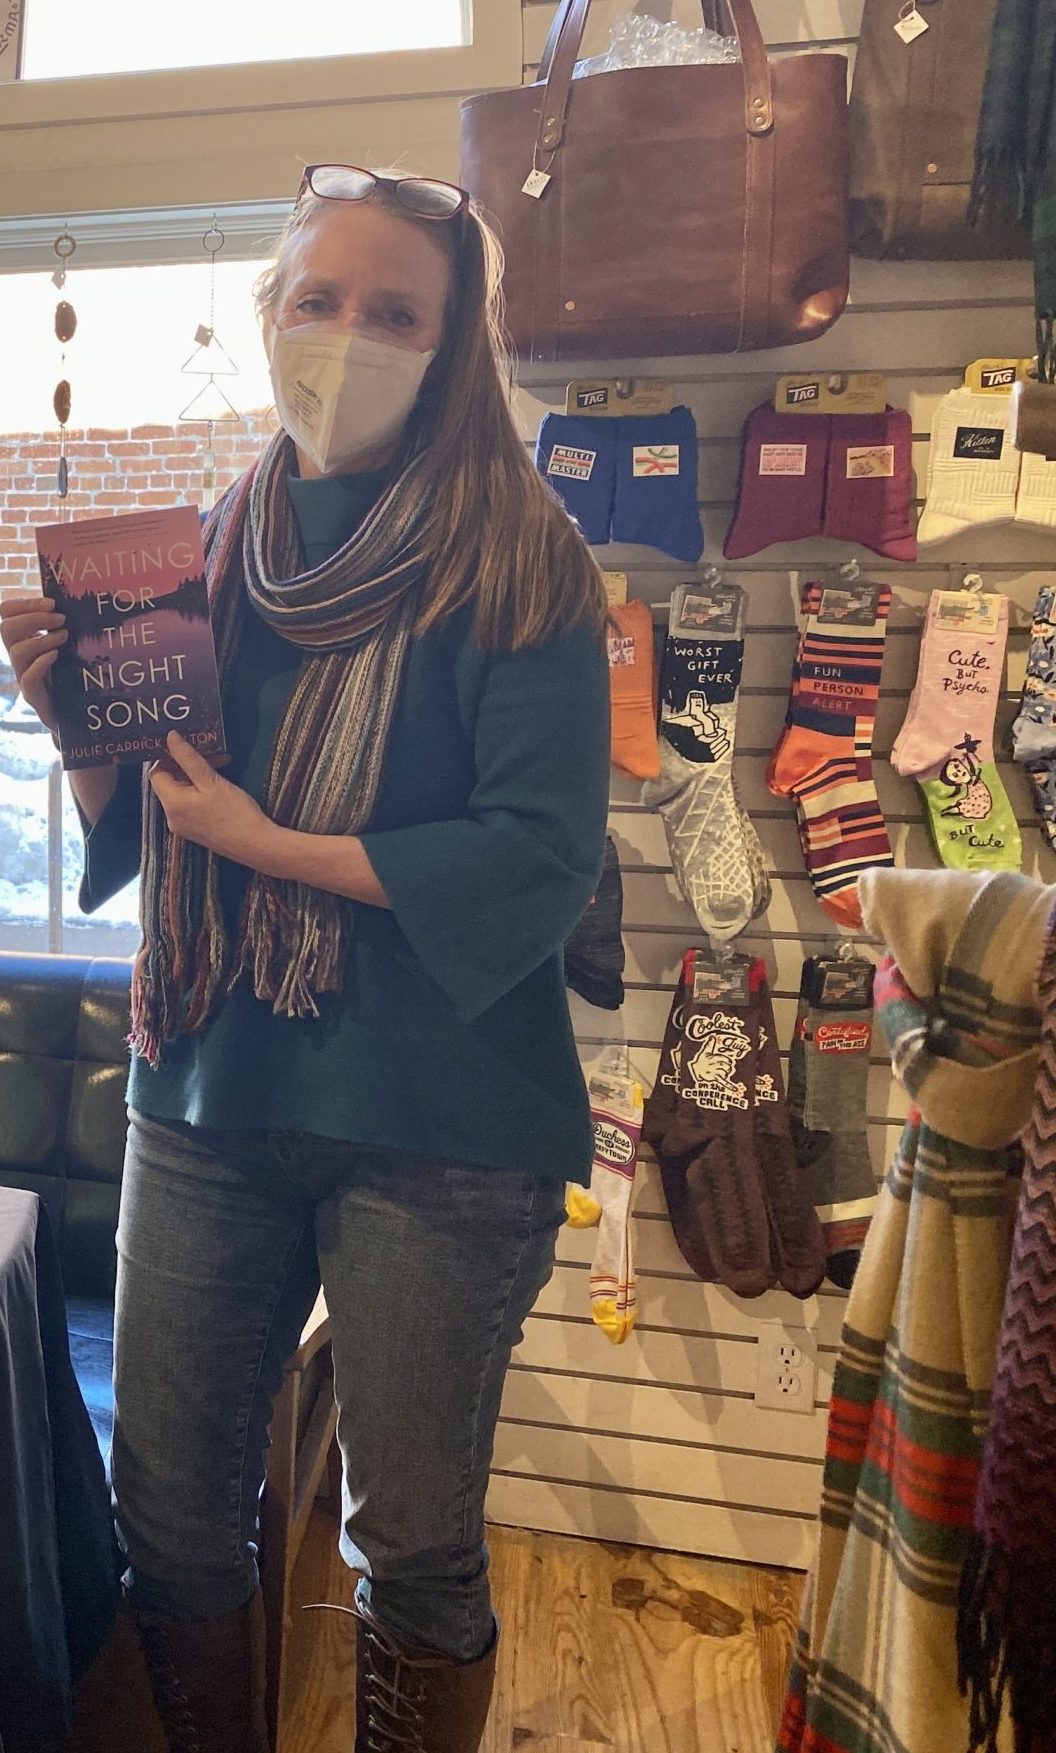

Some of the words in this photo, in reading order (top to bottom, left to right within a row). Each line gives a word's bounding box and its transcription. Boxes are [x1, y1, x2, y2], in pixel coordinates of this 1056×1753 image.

[983, 370, 1014, 386] TAG
[579, 390, 605, 406] TAG
[788, 386, 818, 402] TAG
[557, 449, 589, 461] MULTI
[551, 464, 589, 477] MASTER
[50, 542, 196, 584] WAITING
[96, 587, 155, 615] FOR
[103, 622, 156, 649] THE
[675, 647, 722, 657] WORST
[82, 654, 187, 692] NIGHT
[688, 661, 719, 671] GIFT
[814, 666, 841, 678] FUN
[698, 674, 733, 684] EVER
[813, 681, 864, 695] PERSON
[87, 694, 191, 730] SONG
[812, 697, 852, 711] ALERT
[69, 744, 102, 759] JULIE
[105, 738, 162, 755] CARRICK
[687, 1013, 745, 1040] Coolest
[685, 1089, 746, 1108] CONFERENCE
[593, 1122, 631, 1148] Duchess
